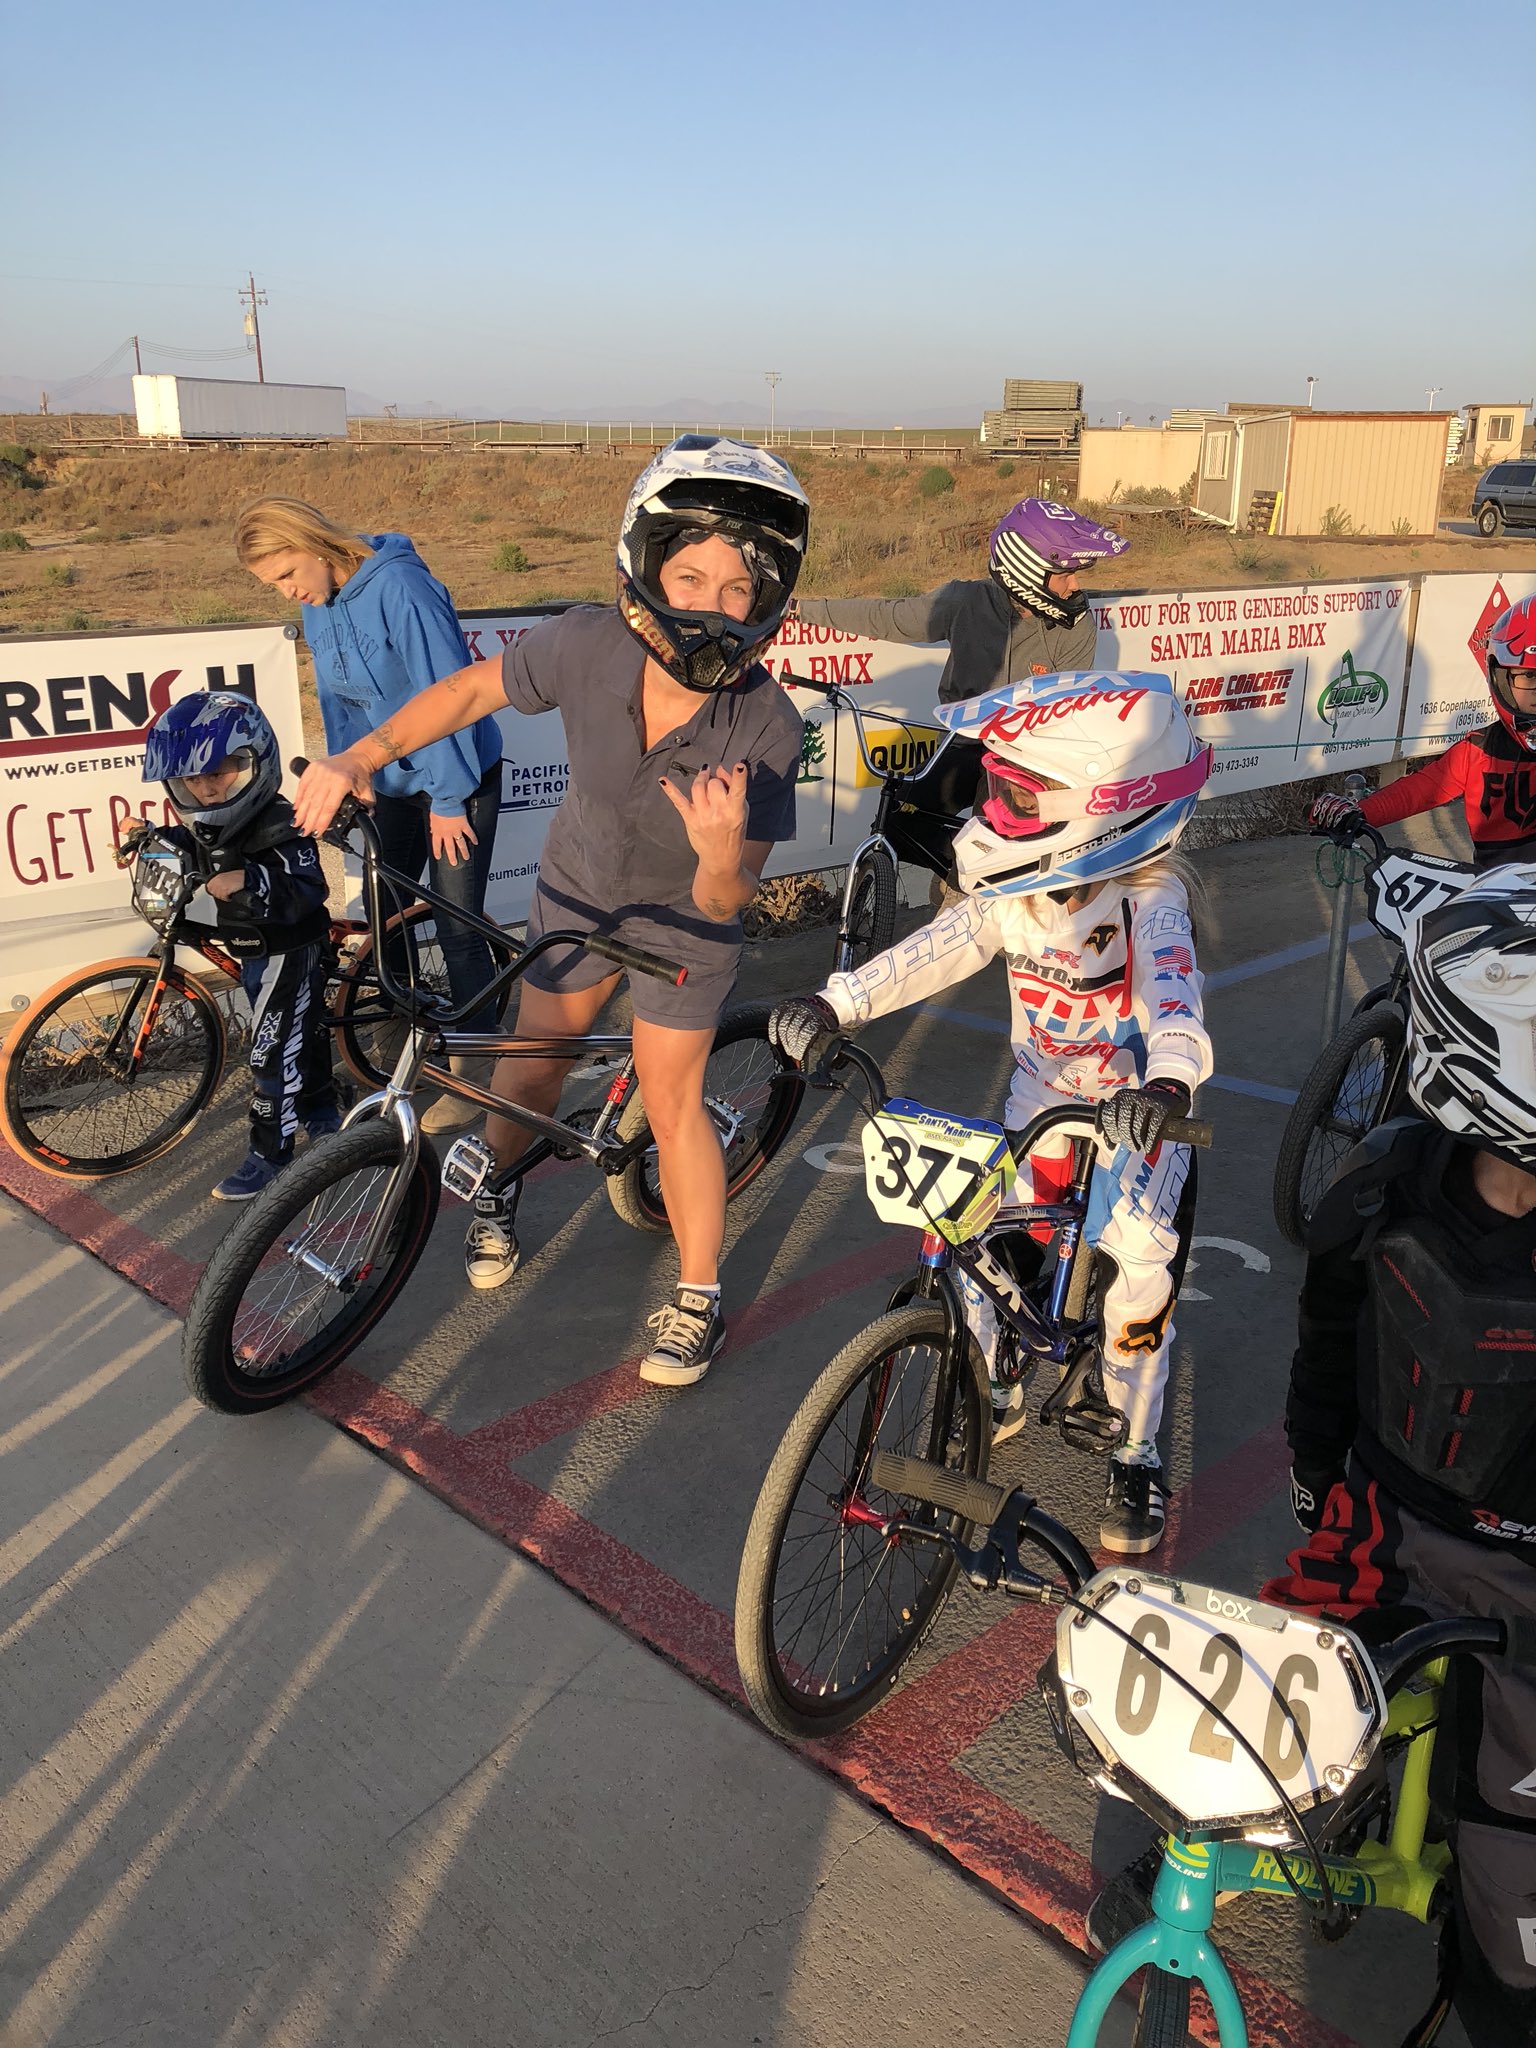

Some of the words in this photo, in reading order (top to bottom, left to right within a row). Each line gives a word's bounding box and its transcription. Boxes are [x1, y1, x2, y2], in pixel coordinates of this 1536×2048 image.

[726, 520, 743, 530] FOX
[995, 564, 1068, 620] FASTHOUSE
[1119, 605, 1151, 629] YOU
[1158, 602, 1190, 626] FOR
[1197, 600, 1237, 623] YOUR
[1243, 594, 1319, 620] GENEROUS
[1324, 591, 1382, 614] SUPPORT
[1386, 589, 1403, 609] OF
[1151, 631, 1212, 662] SANTA
[1220, 625, 1281, 656] MARIA
[1287, 622, 1327, 649] BMX
[809, 653, 873, 687] BMX
[1226, 668, 1294, 696] CONCRETE
[978, 686, 1149, 742] Racing
[1420, 702, 1438, 715] 1636
[1440, 698, 1486, 713] Copenhagen
[1456, 714, 1474, 728] (805)
[7, 802, 96, 886] GET
[1411, 852, 1460, 869] TANGENT
[1384, 871, 1466, 914] 677
[250, 1010, 283, 1068] FOX
[1030, 1023, 1119, 1075] Racing
[919, 1115, 949, 1129] SANTA
[944, 1125, 973, 1139] MARIA
[875, 1136, 993, 1222] 377
[1206, 1589, 1253, 1623] box
[1115, 1613, 1319, 1781] 626
[1250, 1848, 1360, 1897] REDLINE
